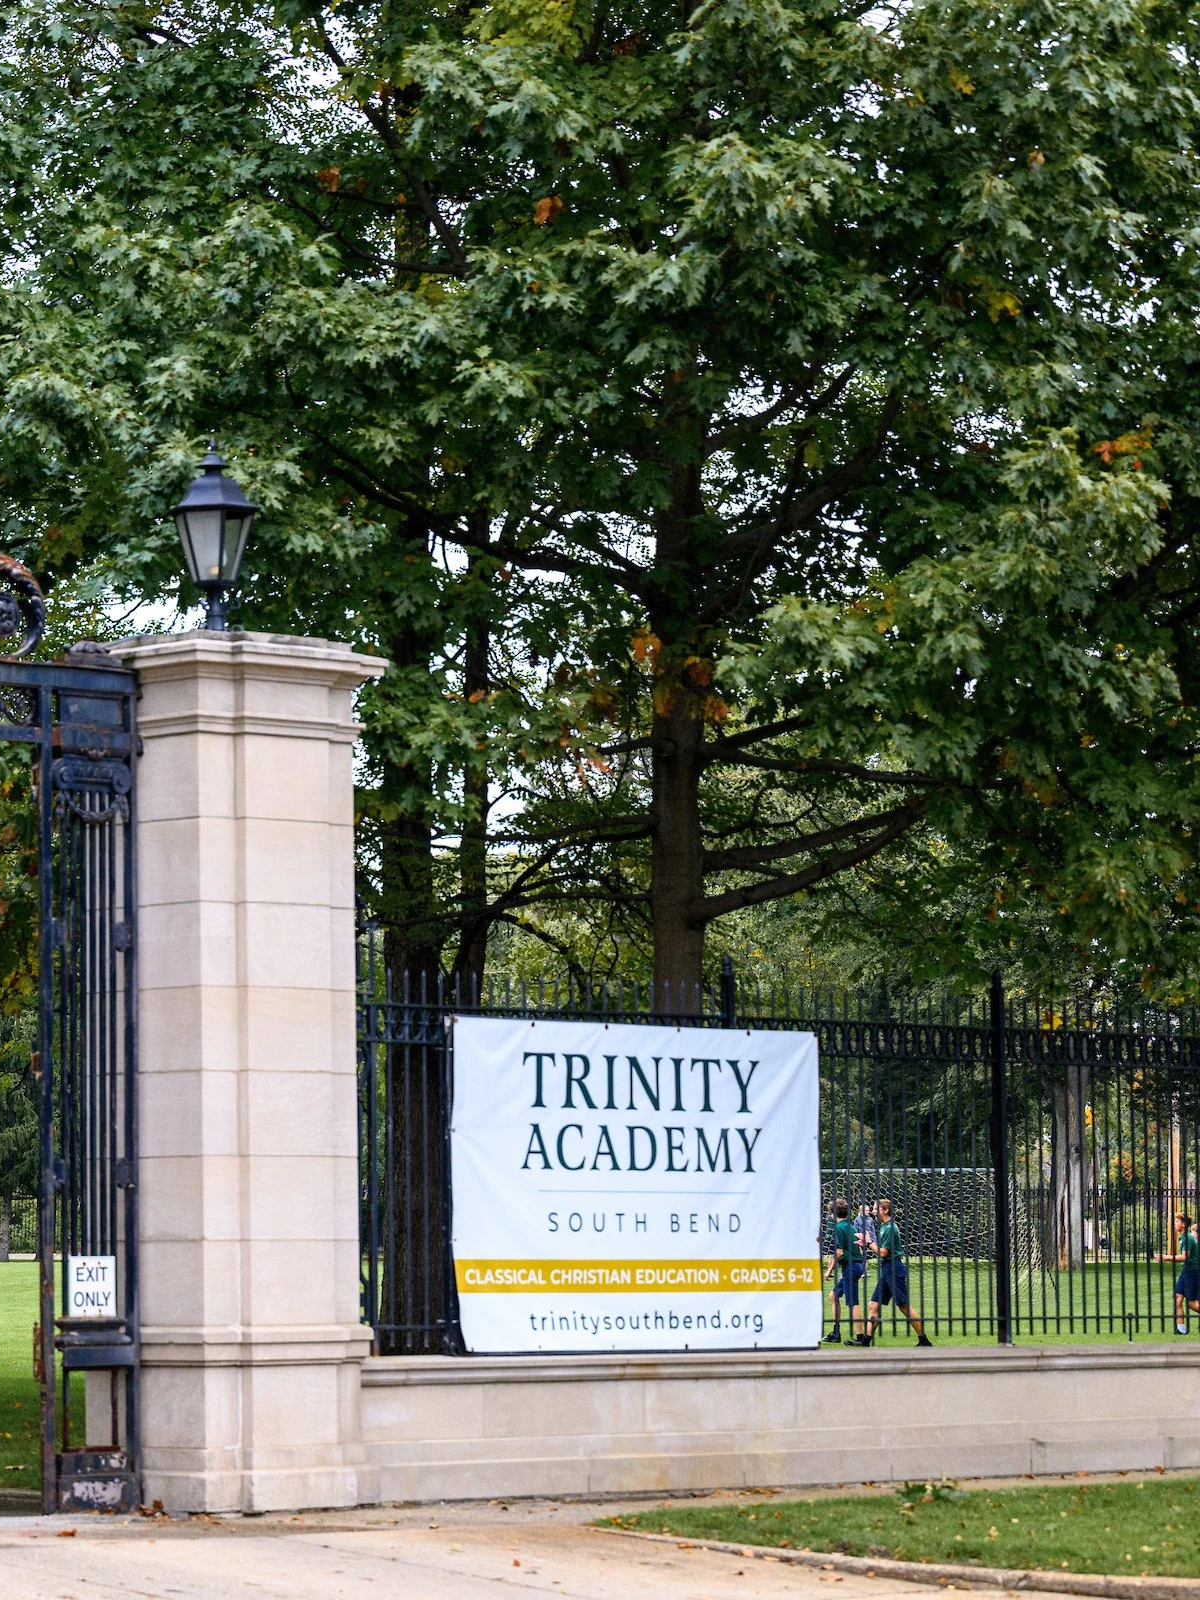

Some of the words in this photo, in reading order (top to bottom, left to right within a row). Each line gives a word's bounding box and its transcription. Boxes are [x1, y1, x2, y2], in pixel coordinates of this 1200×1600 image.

[523, 1051, 760, 1114] TRINITY
[521, 1123, 763, 1173] ACADEMY
[548, 1212, 648, 1233] SOUTH
[671, 1213, 741, 1233] BEND
[76, 1266, 108, 1282] EXIT
[465, 1268, 547, 1285] CLASSICAL
[550, 1268, 633, 1285] CHRISTIAN
[635, 1268, 719, 1285] EDUCATION
[730, 1268, 786, 1284] GRADES
[74, 1291, 111, 1307] ONLY
[529, 1309, 764, 1336] trinitysouthbend.org
